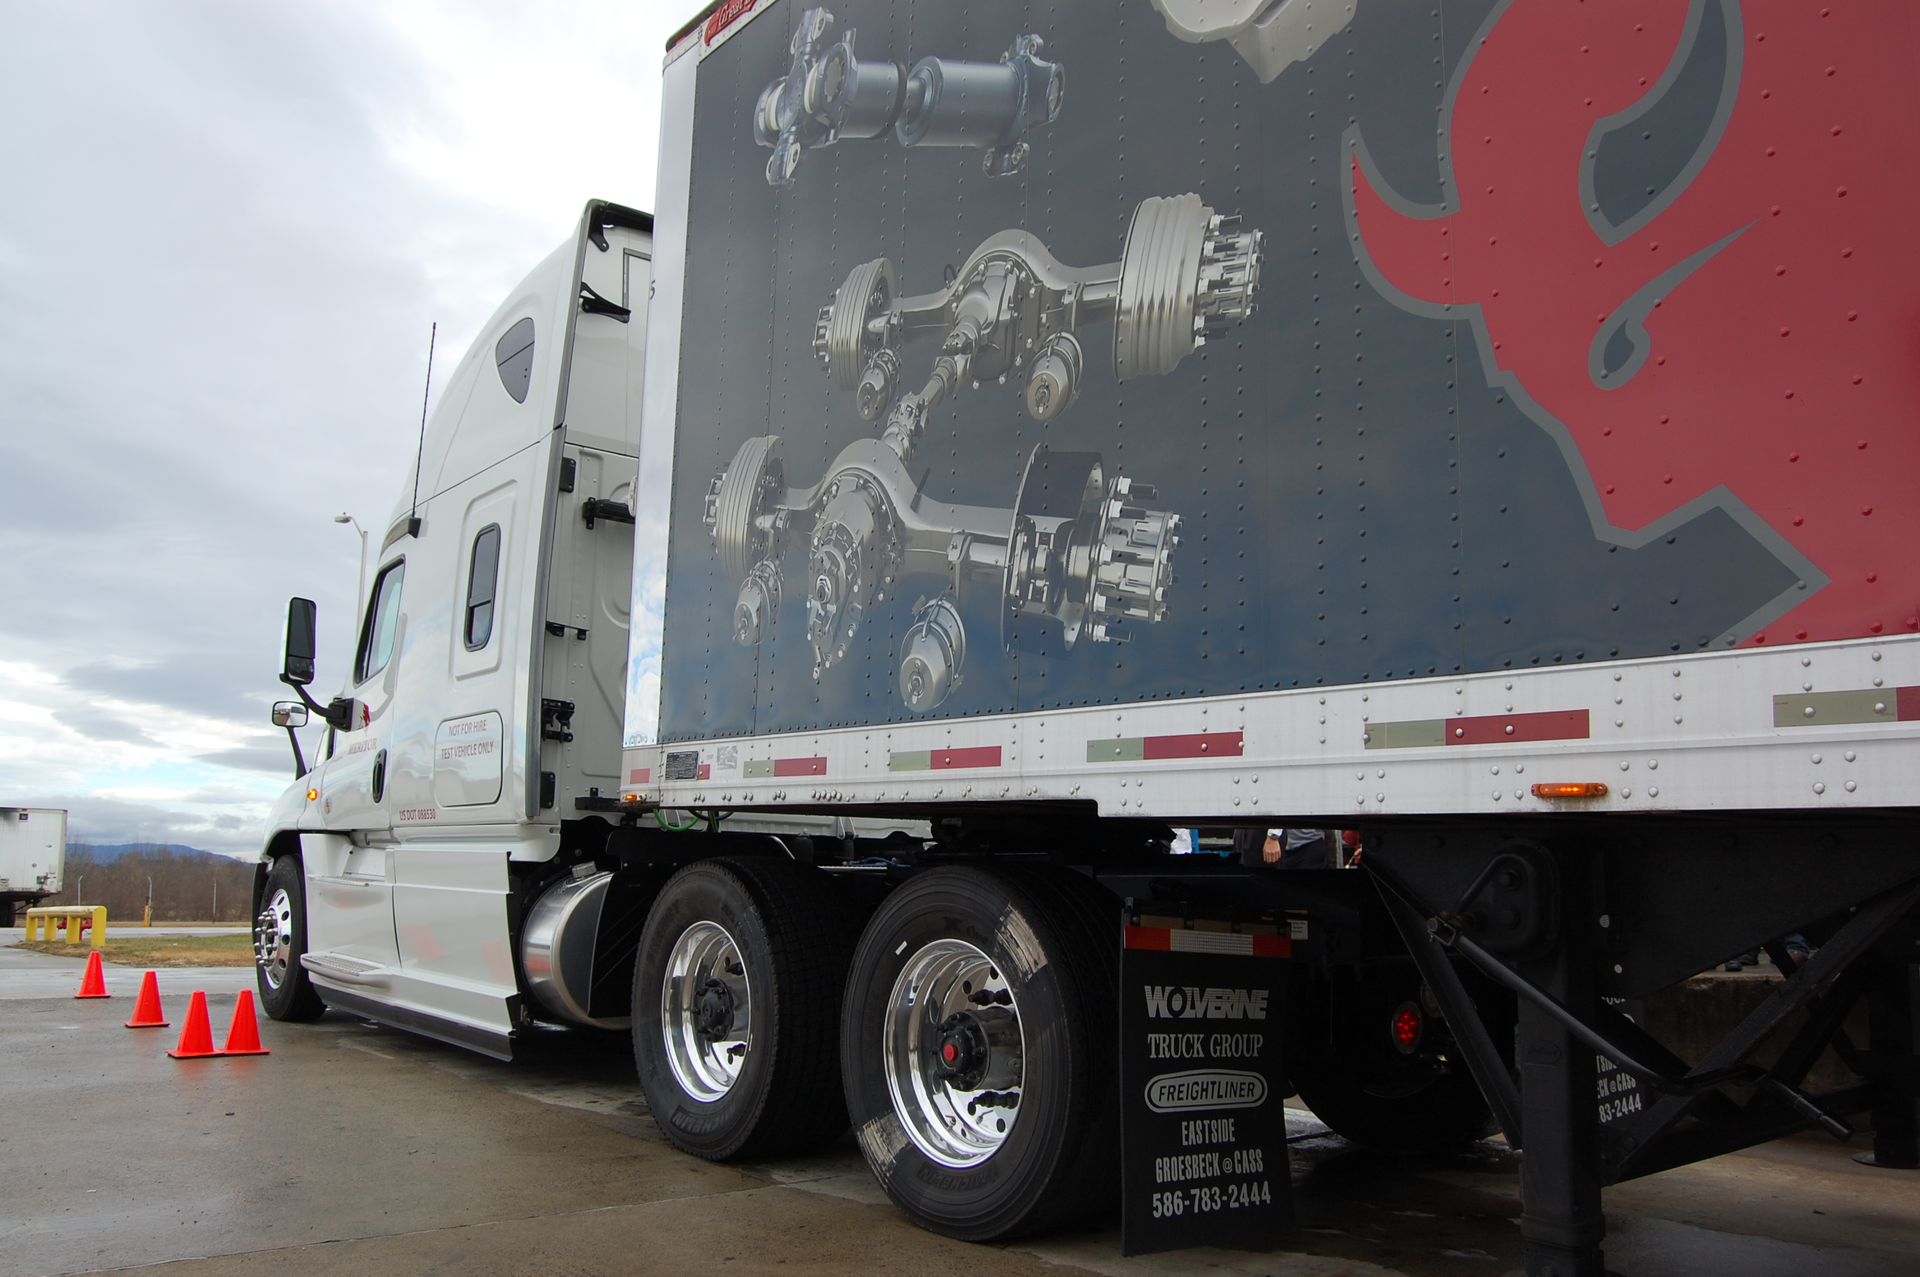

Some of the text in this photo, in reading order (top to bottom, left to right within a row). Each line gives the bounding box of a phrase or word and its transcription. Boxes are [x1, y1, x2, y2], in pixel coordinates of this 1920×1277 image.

[448, 719, 487, 737] NOT FOR HIRE
[441, 740, 494, 760] TEST VEHICLE ONLY
[399, 809, 406, 821] US
[407, 809, 416, 821] DOT
[1144, 985, 1269, 1019] WOLVERINE
[1147, 1033, 1264, 1058] TRUCK GROUP
[1158, 1081, 1256, 1102] FREIGHTLINER
[1598, 1093, 1642, 1123] 83-2444
[1181, 1118, 1236, 1146] EASTSIDE
[1155, 1152, 1221, 1183] GROESBECK
[1234, 1148, 1264, 1175] CASS
[1152, 1180, 1271, 1218] 586-783-2444
